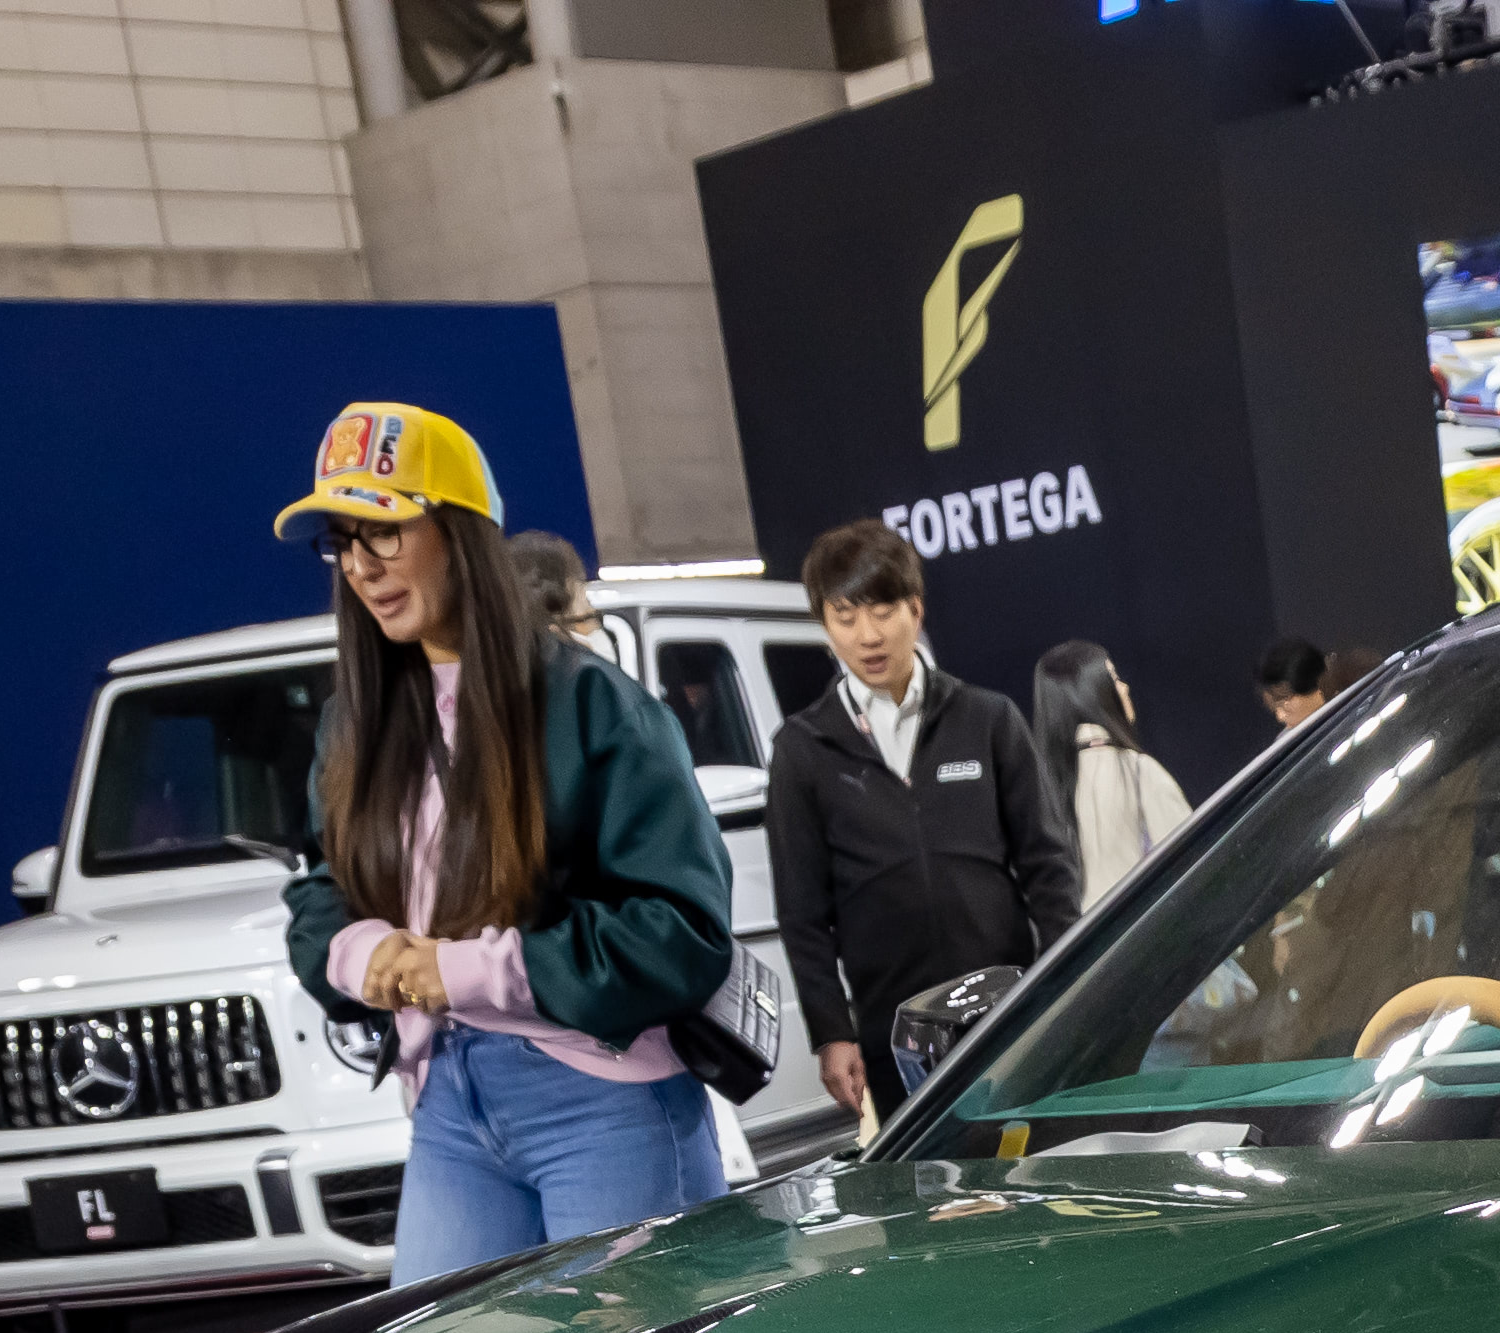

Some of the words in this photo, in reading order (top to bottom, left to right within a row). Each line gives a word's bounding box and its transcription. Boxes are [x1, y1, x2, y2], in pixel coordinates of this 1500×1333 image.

[882, 464, 1103, 560] FORTEGA
[936, 759, 983, 783] BBS
[77, 1187, 117, 1224] FL
